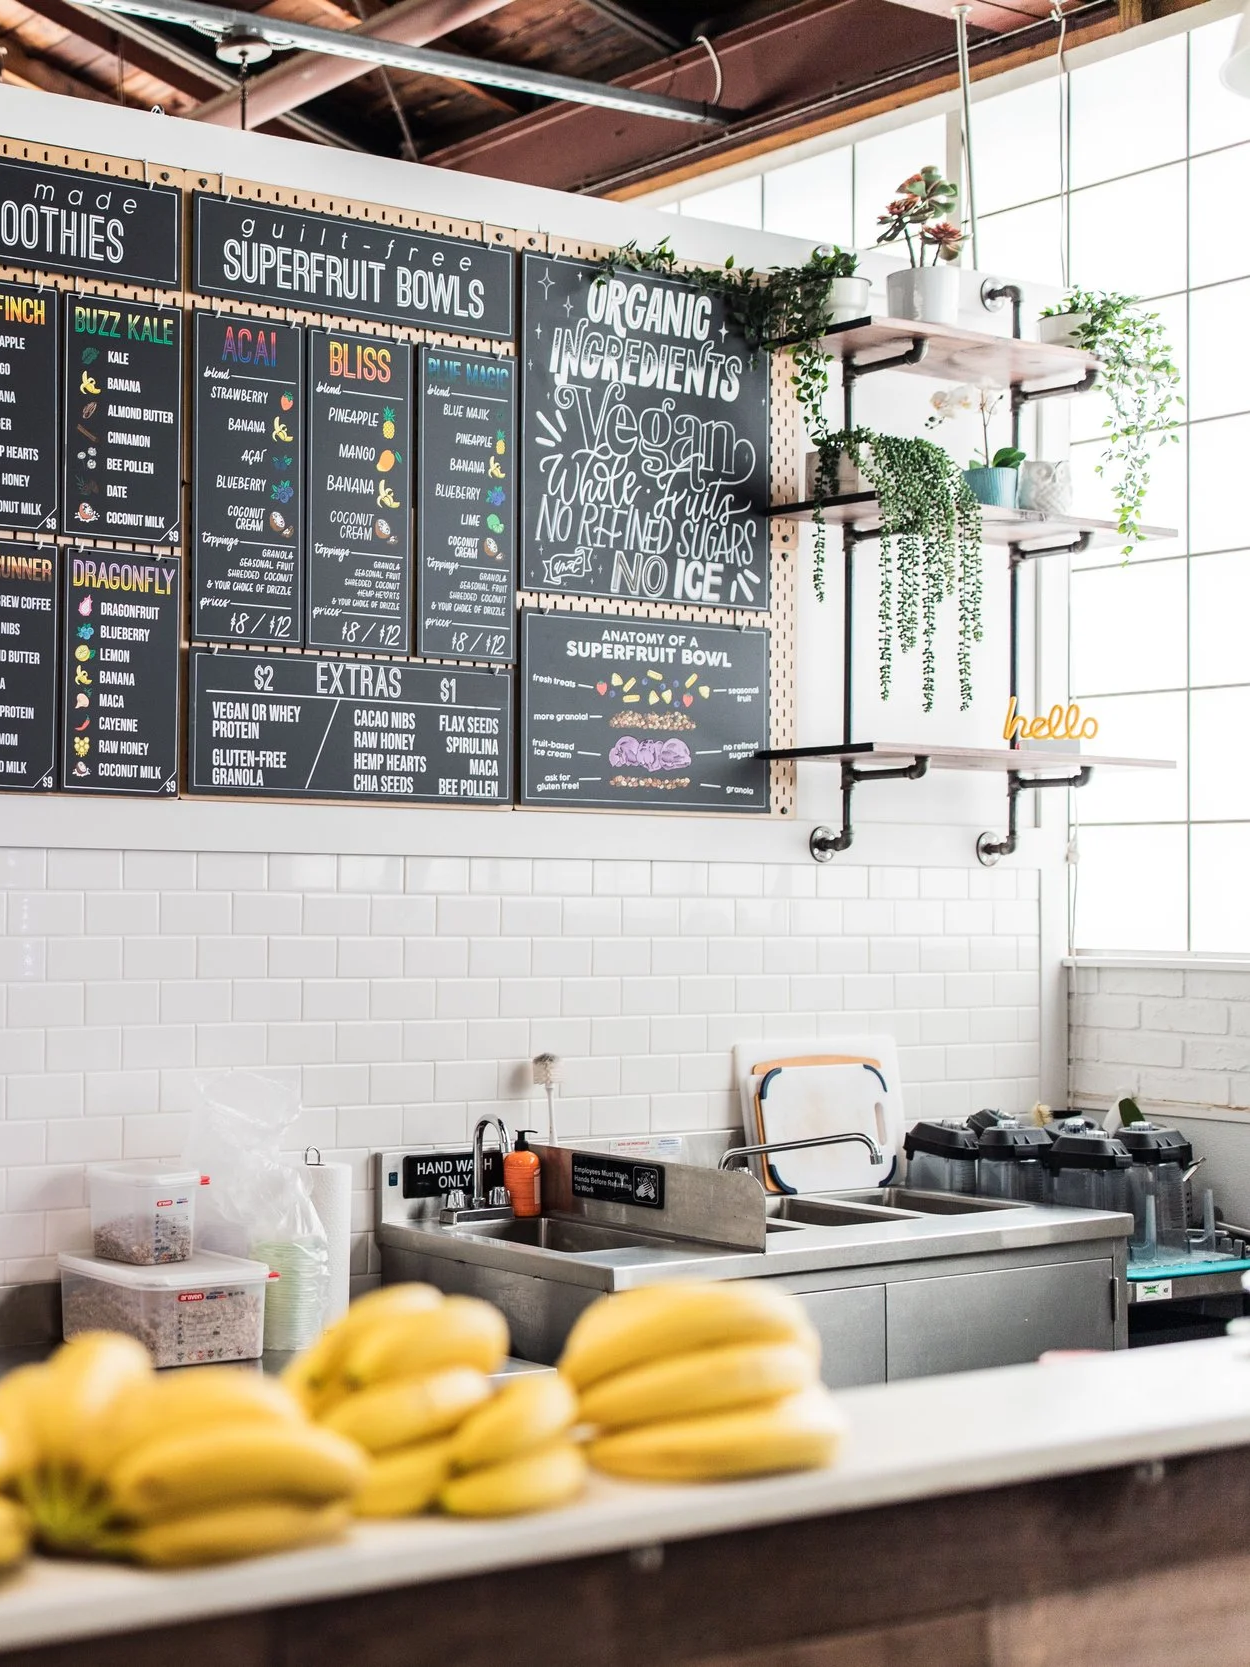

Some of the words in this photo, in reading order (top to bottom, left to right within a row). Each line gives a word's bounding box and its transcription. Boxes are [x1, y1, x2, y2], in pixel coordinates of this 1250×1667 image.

[34, 182, 138, 214] made
[240, 217, 472, 272] guilt-free
[223, 238, 386, 303] SUPERFRUIT
[397, 266, 485, 320] BOWLS
[587, 277, 712, 341] ORGANIC
[74, 306, 121, 338] BUZZ
[127, 313, 175, 346] KALE
[222, 326, 277, 368] ACAI
[108, 350, 130, 365] KALE
[329, 341, 391, 383] BLISS
[549, 318, 743, 402] INGREDIENTS
[204, 366, 230, 380] blend
[107, 377, 141, 394] BANANA
[316, 381, 341, 395] blend
[107, 405, 142, 420] ALMOND
[143, 408, 174, 425] BUTTER
[443, 403, 464, 417] BLUE
[107, 431, 151, 448] CINNAMON
[554, 381, 756, 492] Vegan
[7, 445, 39, 461] HEARTS
[540, 443, 643, 505] Whole
[654, 453, 752, 525] Fruits
[227, 505, 265, 520] COCONUT
[460, 514, 481, 527] LIME
[46, 517, 57, 530] $8
[235, 518, 264, 532] CREAM
[535, 494, 573, 543] NO
[577, 502, 673, 554] REFINED
[676, 518, 757, 567] SUGARS
[169, 530, 179, 543] $9
[201, 531, 240, 551] toppings
[262, 549, 294, 560] GRANOLA
[239, 558, 274, 569] SEASONAL
[276, 562, 294, 571] FRUIT
[553, 558, 583, 574] and
[73, 559, 176, 595] DRAGONFLY
[611, 550, 668, 598] NO
[674, 559, 724, 601] ICE
[207, 580, 213, 589] &
[215, 580, 231, 591] YOUR
[233, 582, 254, 593] CHOICE
[256, 584, 265, 593] OF
[267, 585, 292, 596] DRIZZLE
[100, 602, 160, 620] DRAGONFRUIT
[200, 596, 230, 610] prices
[230, 612, 249, 634] $8
[269, 615, 292, 637] $12
[100, 625, 151, 643] BLUEBERRY
[602, 630, 665, 644] ANATOMY
[668, 635, 686, 646] OF
[689, 636, 699, 648] A
[566, 640, 677, 663] SUPERFRUIT
[682, 649, 732, 668] BOWL
[254, 664, 274, 692] $2
[316, 662, 402, 698] EXTRAS
[439, 678, 457, 704] $1
[727, 686, 759, 695] seasonal
[737, 694, 752, 702] fruit
[212, 701, 250, 720] VEGAN
[251, 704, 267, 721] OR
[268, 705, 301, 723] WHEY
[1003, 696, 1098, 740] hello
[212, 721, 259, 740] PROTEIN
[439, 714, 465, 732] FLAX
[467, 717, 499, 735] SEEDS
[446, 735, 499, 755] SPIRULINA
[532, 739, 575, 751] fruit-based
[534, 748, 545, 757] ice
[547, 750, 572, 759] cream
[212, 748, 287, 769] GLUTEN-FREE
[726, 785, 754, 795] granola
[417, 1161, 452, 1175] HAND
[456, 1158, 492, 1172] WAH
[574, 1166, 600, 1176] Employees
[615, 1172, 628, 1180] Wash
[438, 1174, 471, 1188] ONLY
[574, 1175, 589, 1183] Hands
